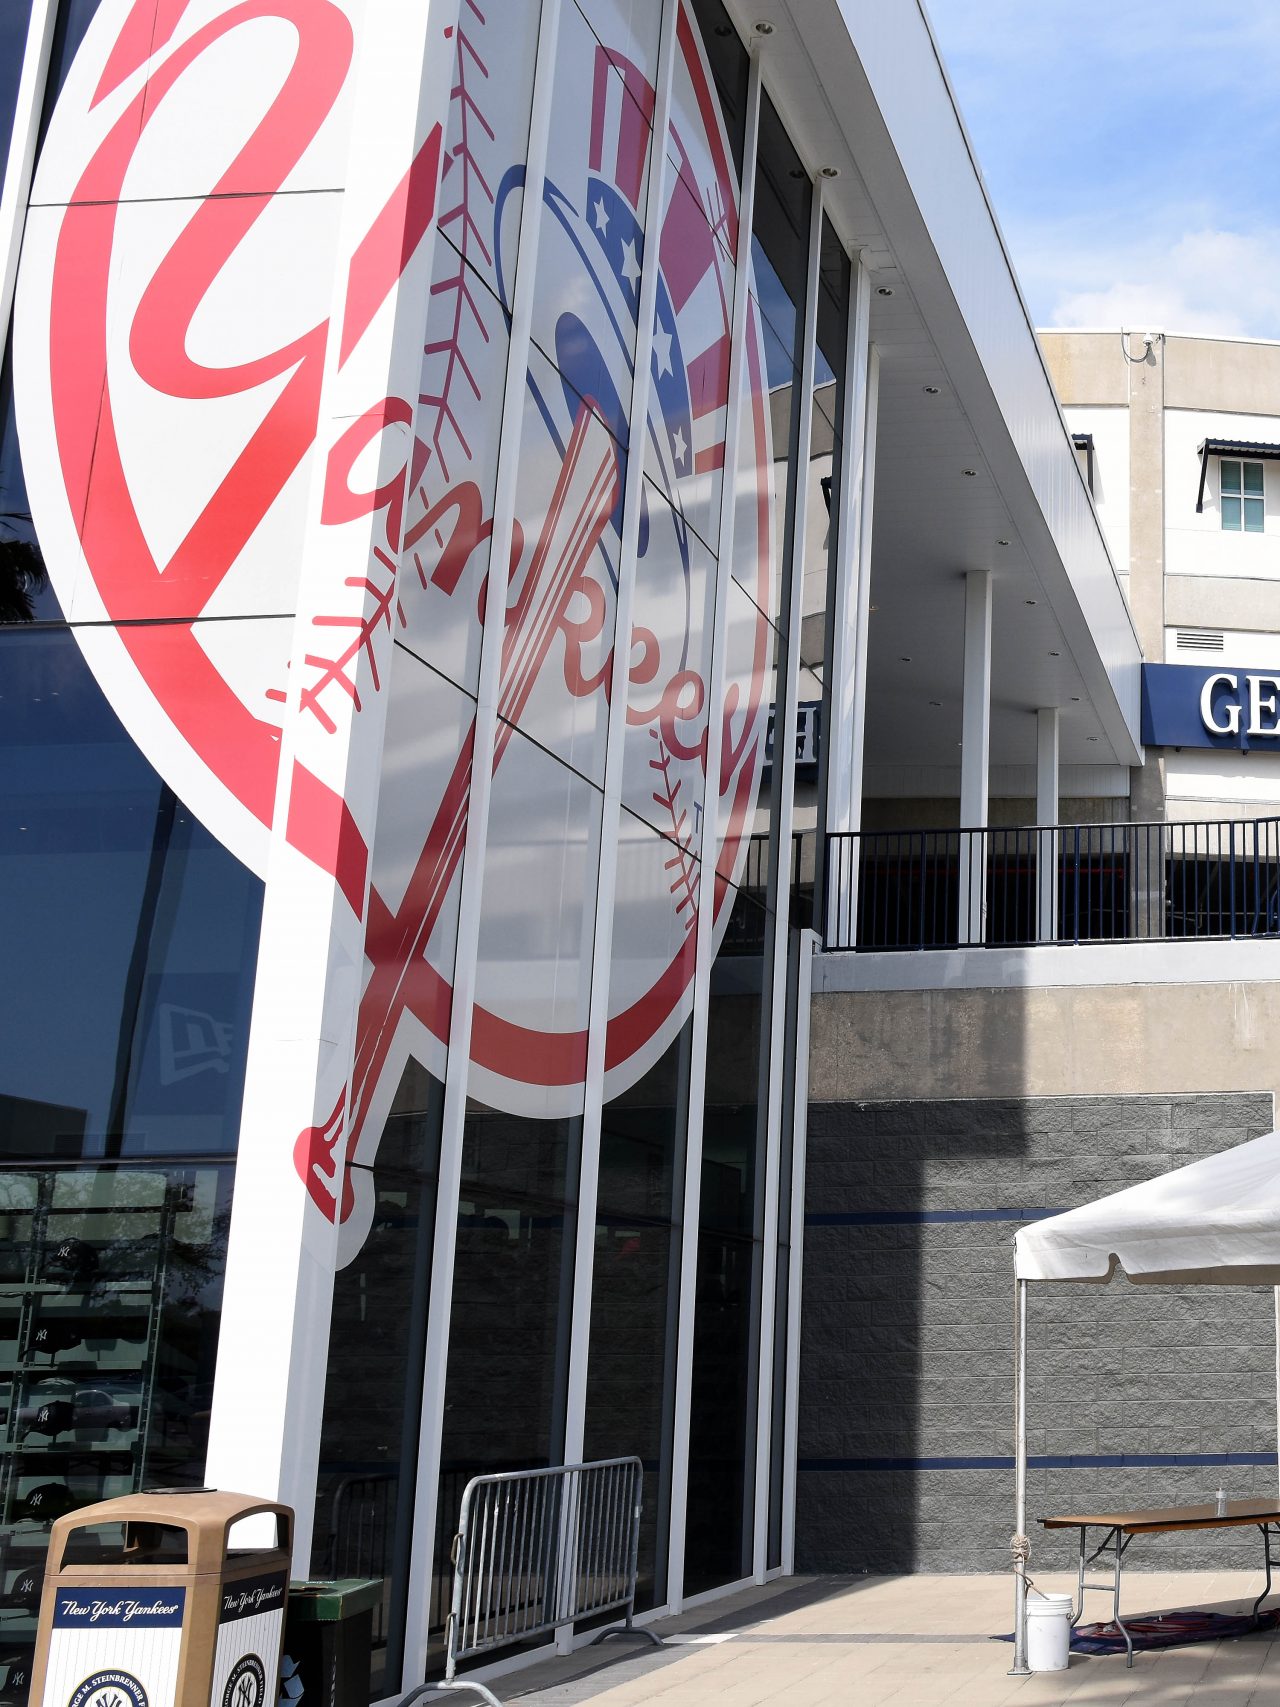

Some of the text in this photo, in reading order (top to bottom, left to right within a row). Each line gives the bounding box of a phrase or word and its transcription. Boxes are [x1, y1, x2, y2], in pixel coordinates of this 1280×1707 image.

[61, 1600, 179, 1622] New York Yankees
[223, 1584, 283, 1613] New York Yankees
[91, 1674, 144, 1701] STEINBRENNER
